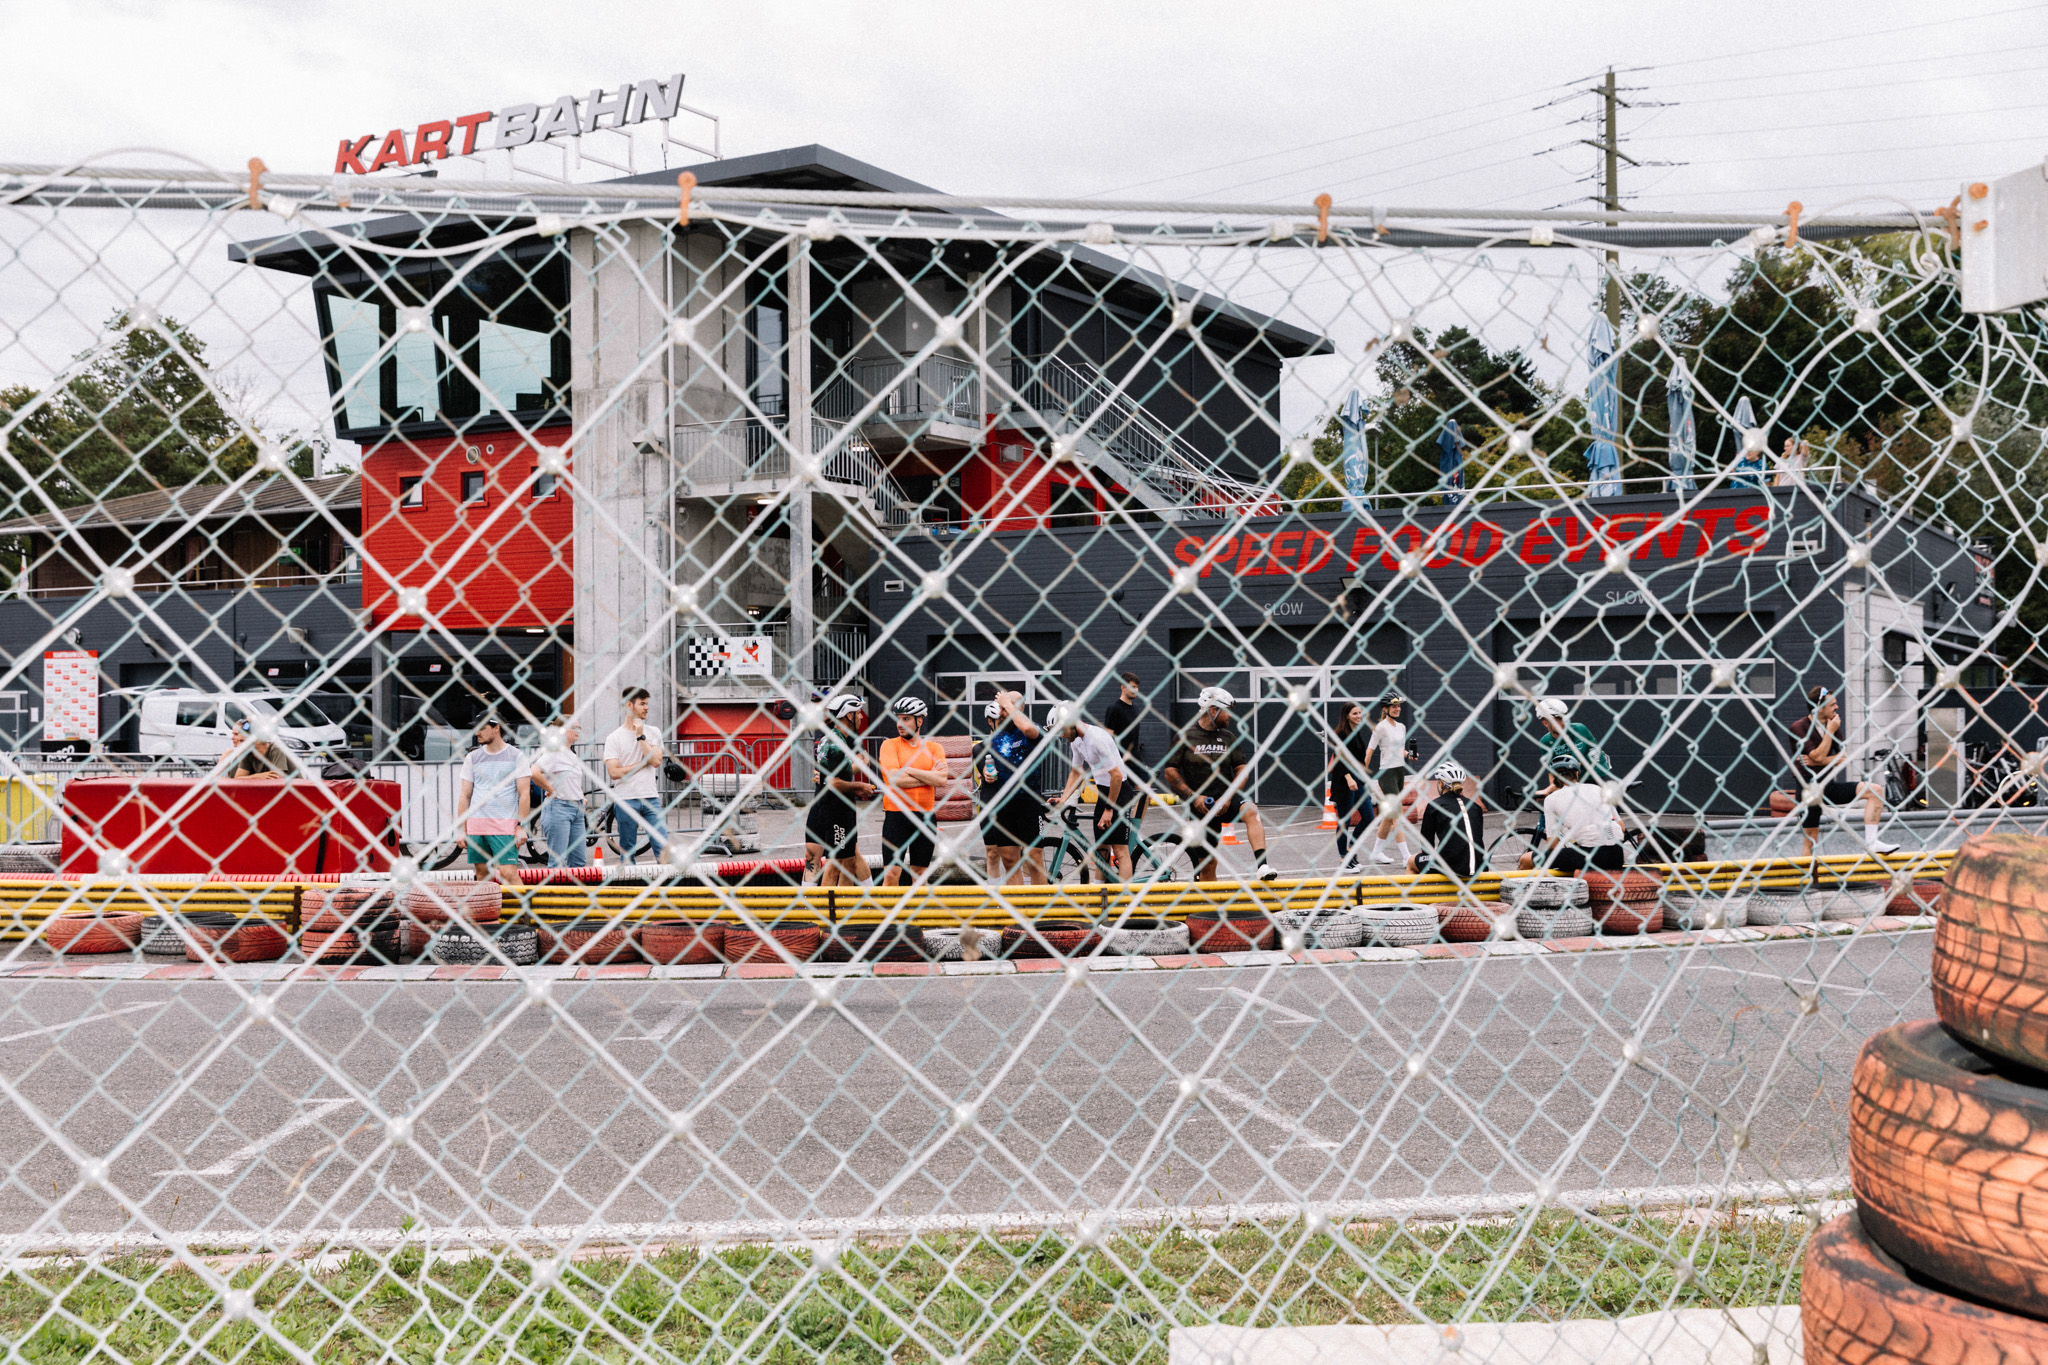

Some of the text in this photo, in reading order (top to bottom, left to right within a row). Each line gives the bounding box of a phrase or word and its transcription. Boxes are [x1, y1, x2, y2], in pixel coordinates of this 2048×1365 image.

[1168, 505, 1772, 579] SPEED FOOD EVENTS
